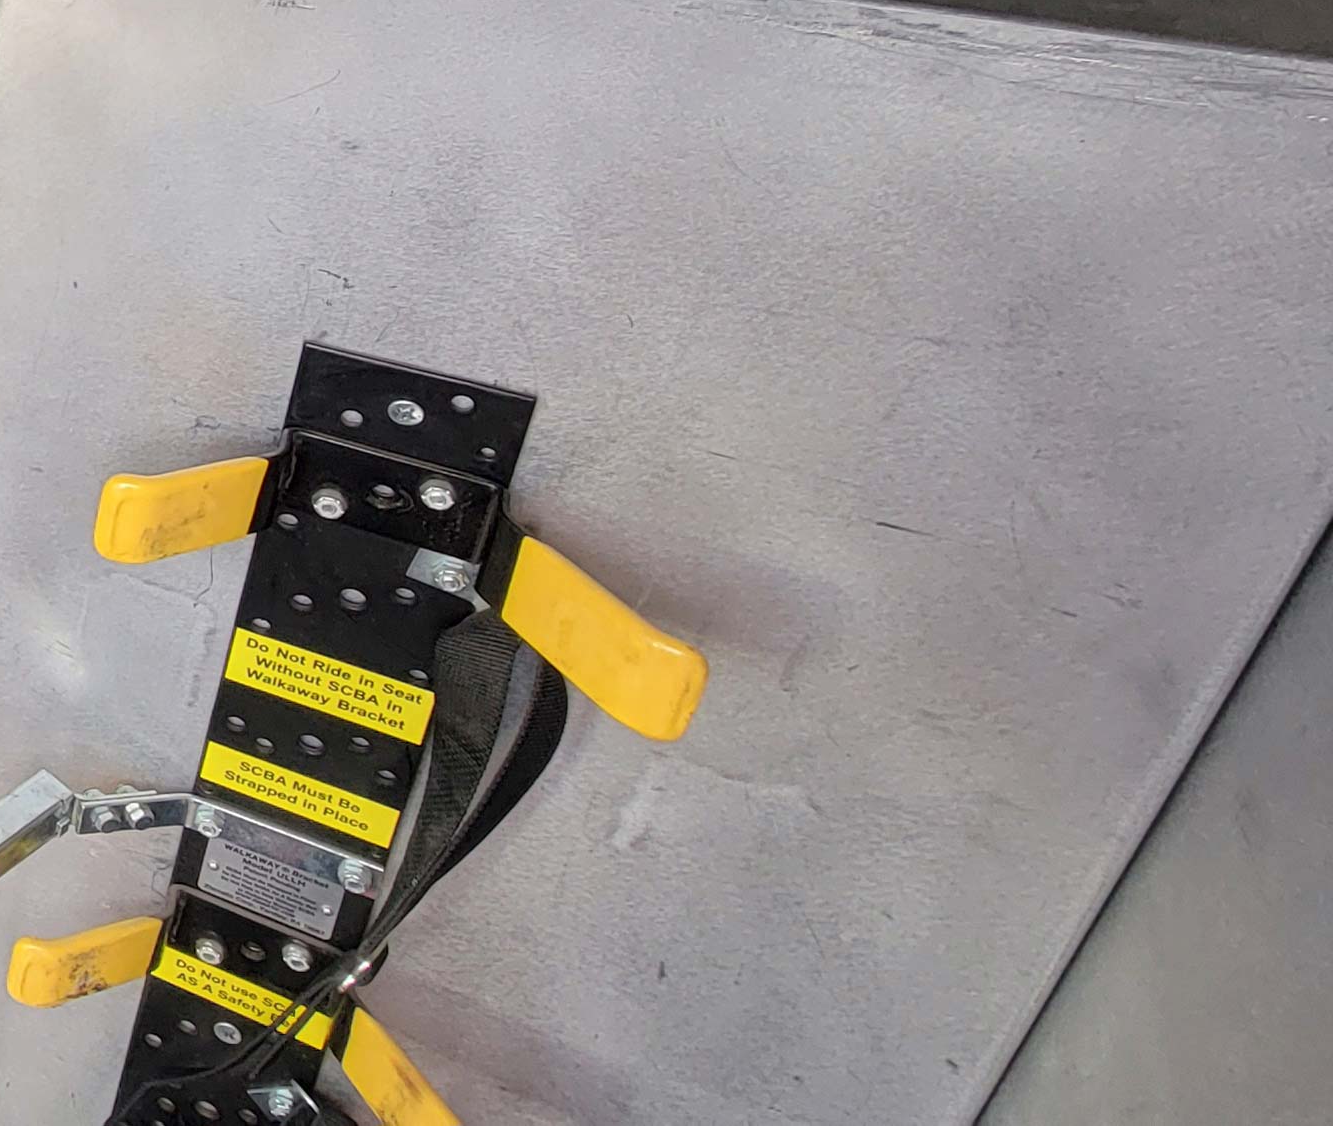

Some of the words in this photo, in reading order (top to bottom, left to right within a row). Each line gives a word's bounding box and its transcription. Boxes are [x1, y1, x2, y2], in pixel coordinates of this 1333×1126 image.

[246, 668, 331, 705] Walkaway
[337, 699, 405, 731] Bracket
[247, 637, 269, 653] Do
[276, 647, 306, 666] Not
[313, 660, 351, 680] Ride
[359, 674, 374, 688] in
[382, 683, 422, 705] Seat
[256, 655, 321, 686] Without
[328, 681, 379, 706] SCBA
[387, 700, 403, 714] in
[224, 770, 298, 805] Strapped
[302, 798, 317, 812] in
[322, 806, 369, 832] Place
[239, 761, 287, 786] SCBA
[292, 782, 333, 804] Must
[338, 797, 361, 814] Be
[224, 843, 281, 869] WALKAWAY
[242, 858, 273, 874] Model
[176, 958, 196, 973] Do
[200, 970, 227, 987] Not
[231, 983, 258, 1000] use
[263, 997, 296, 1018] SCA
[176, 972, 198, 987] AS
[202, 983, 214, 994] A
[217, 990, 265, 1017] Safety
